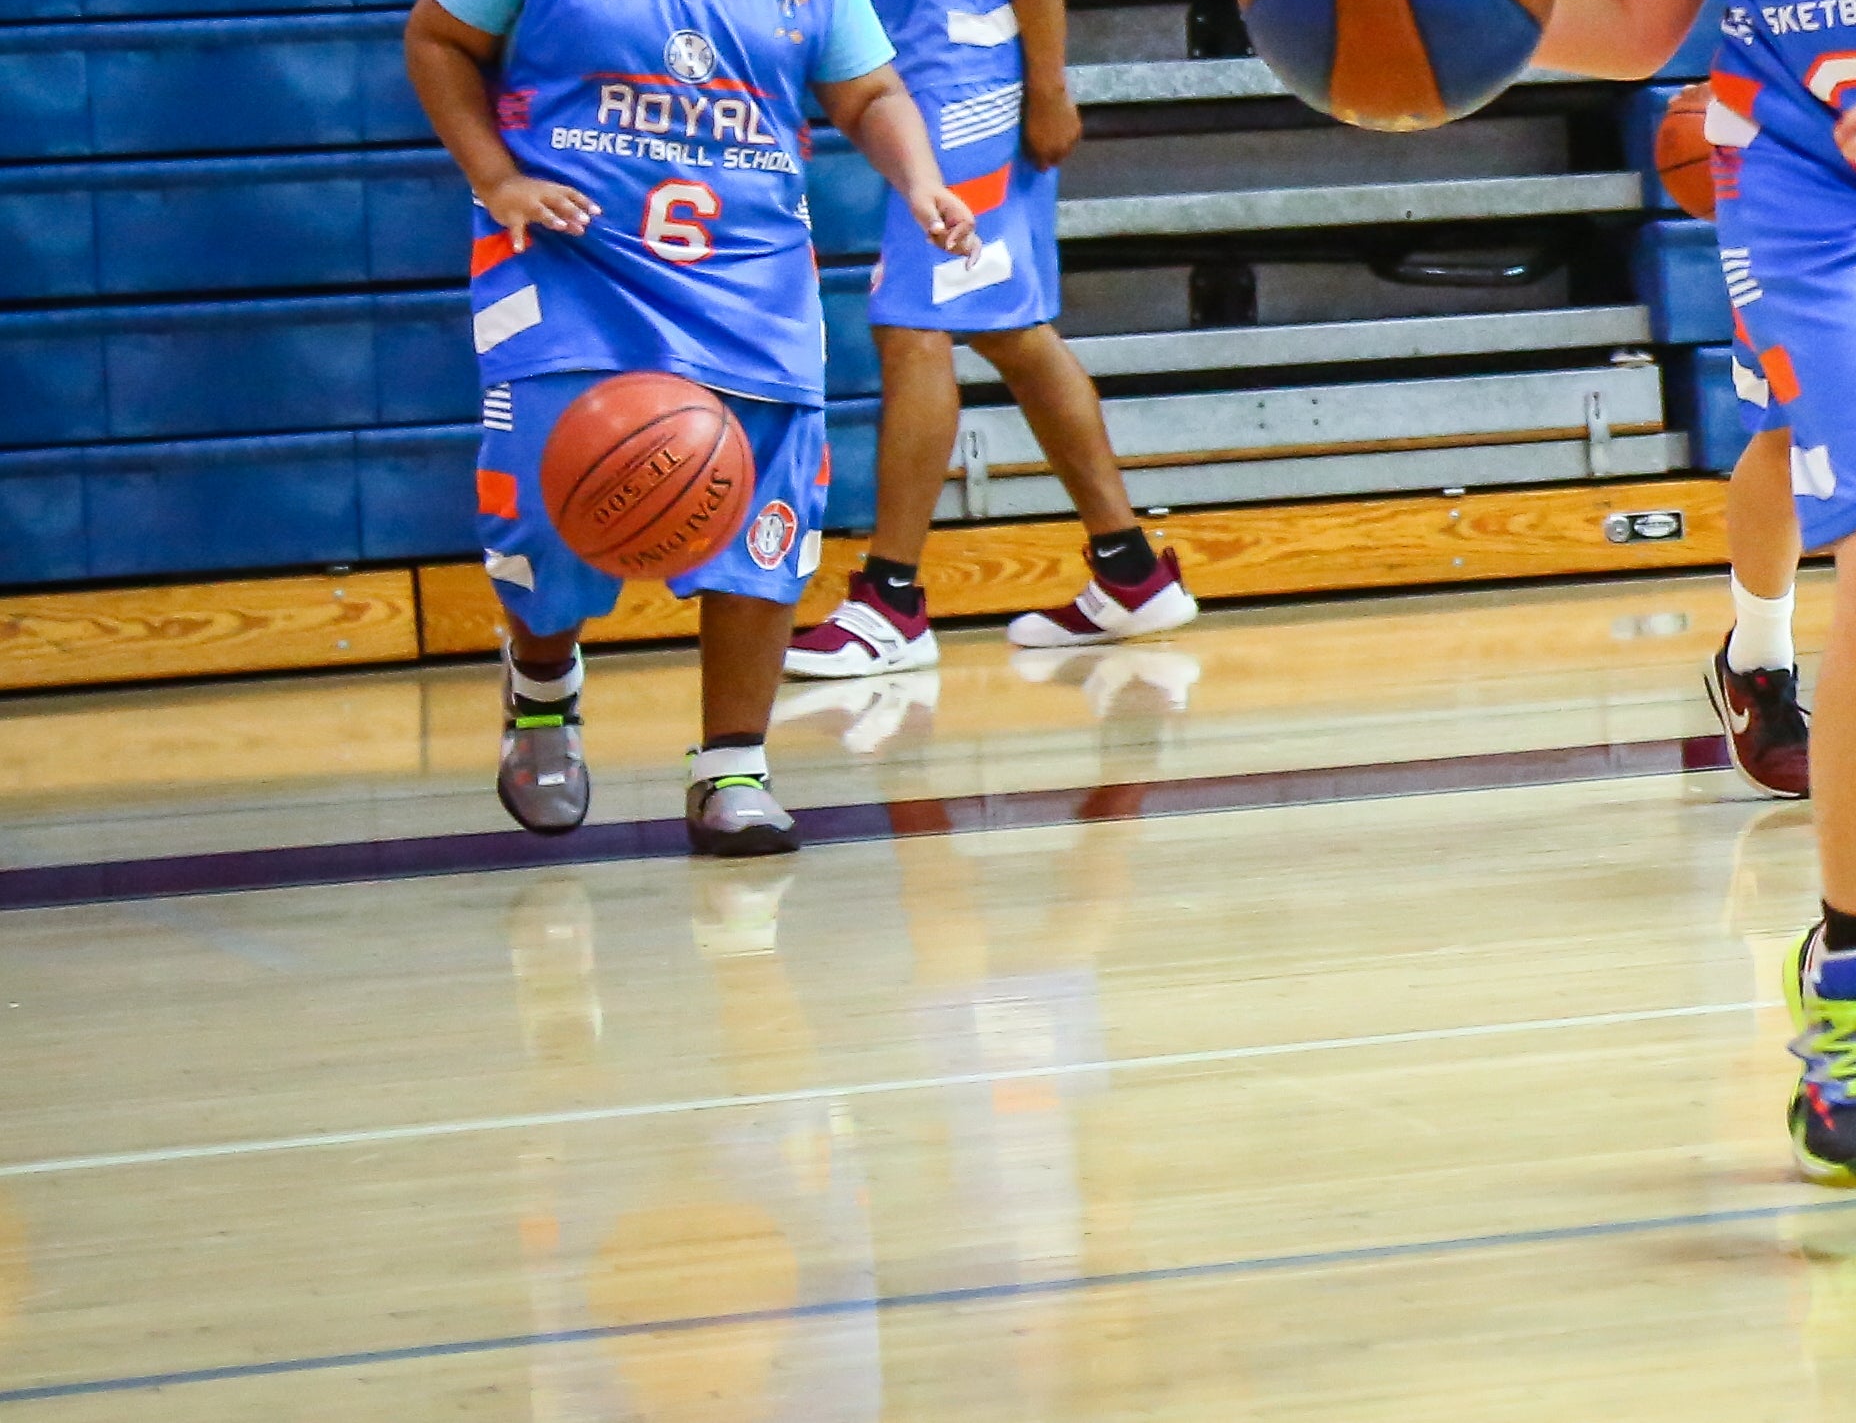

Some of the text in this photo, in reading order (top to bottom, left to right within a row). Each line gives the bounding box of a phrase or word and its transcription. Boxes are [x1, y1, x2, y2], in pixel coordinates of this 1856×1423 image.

[597, 83, 777, 146] ROYAL
[550, 126, 714, 168] BASKETBALL
[641, 178, 723, 266] 6
